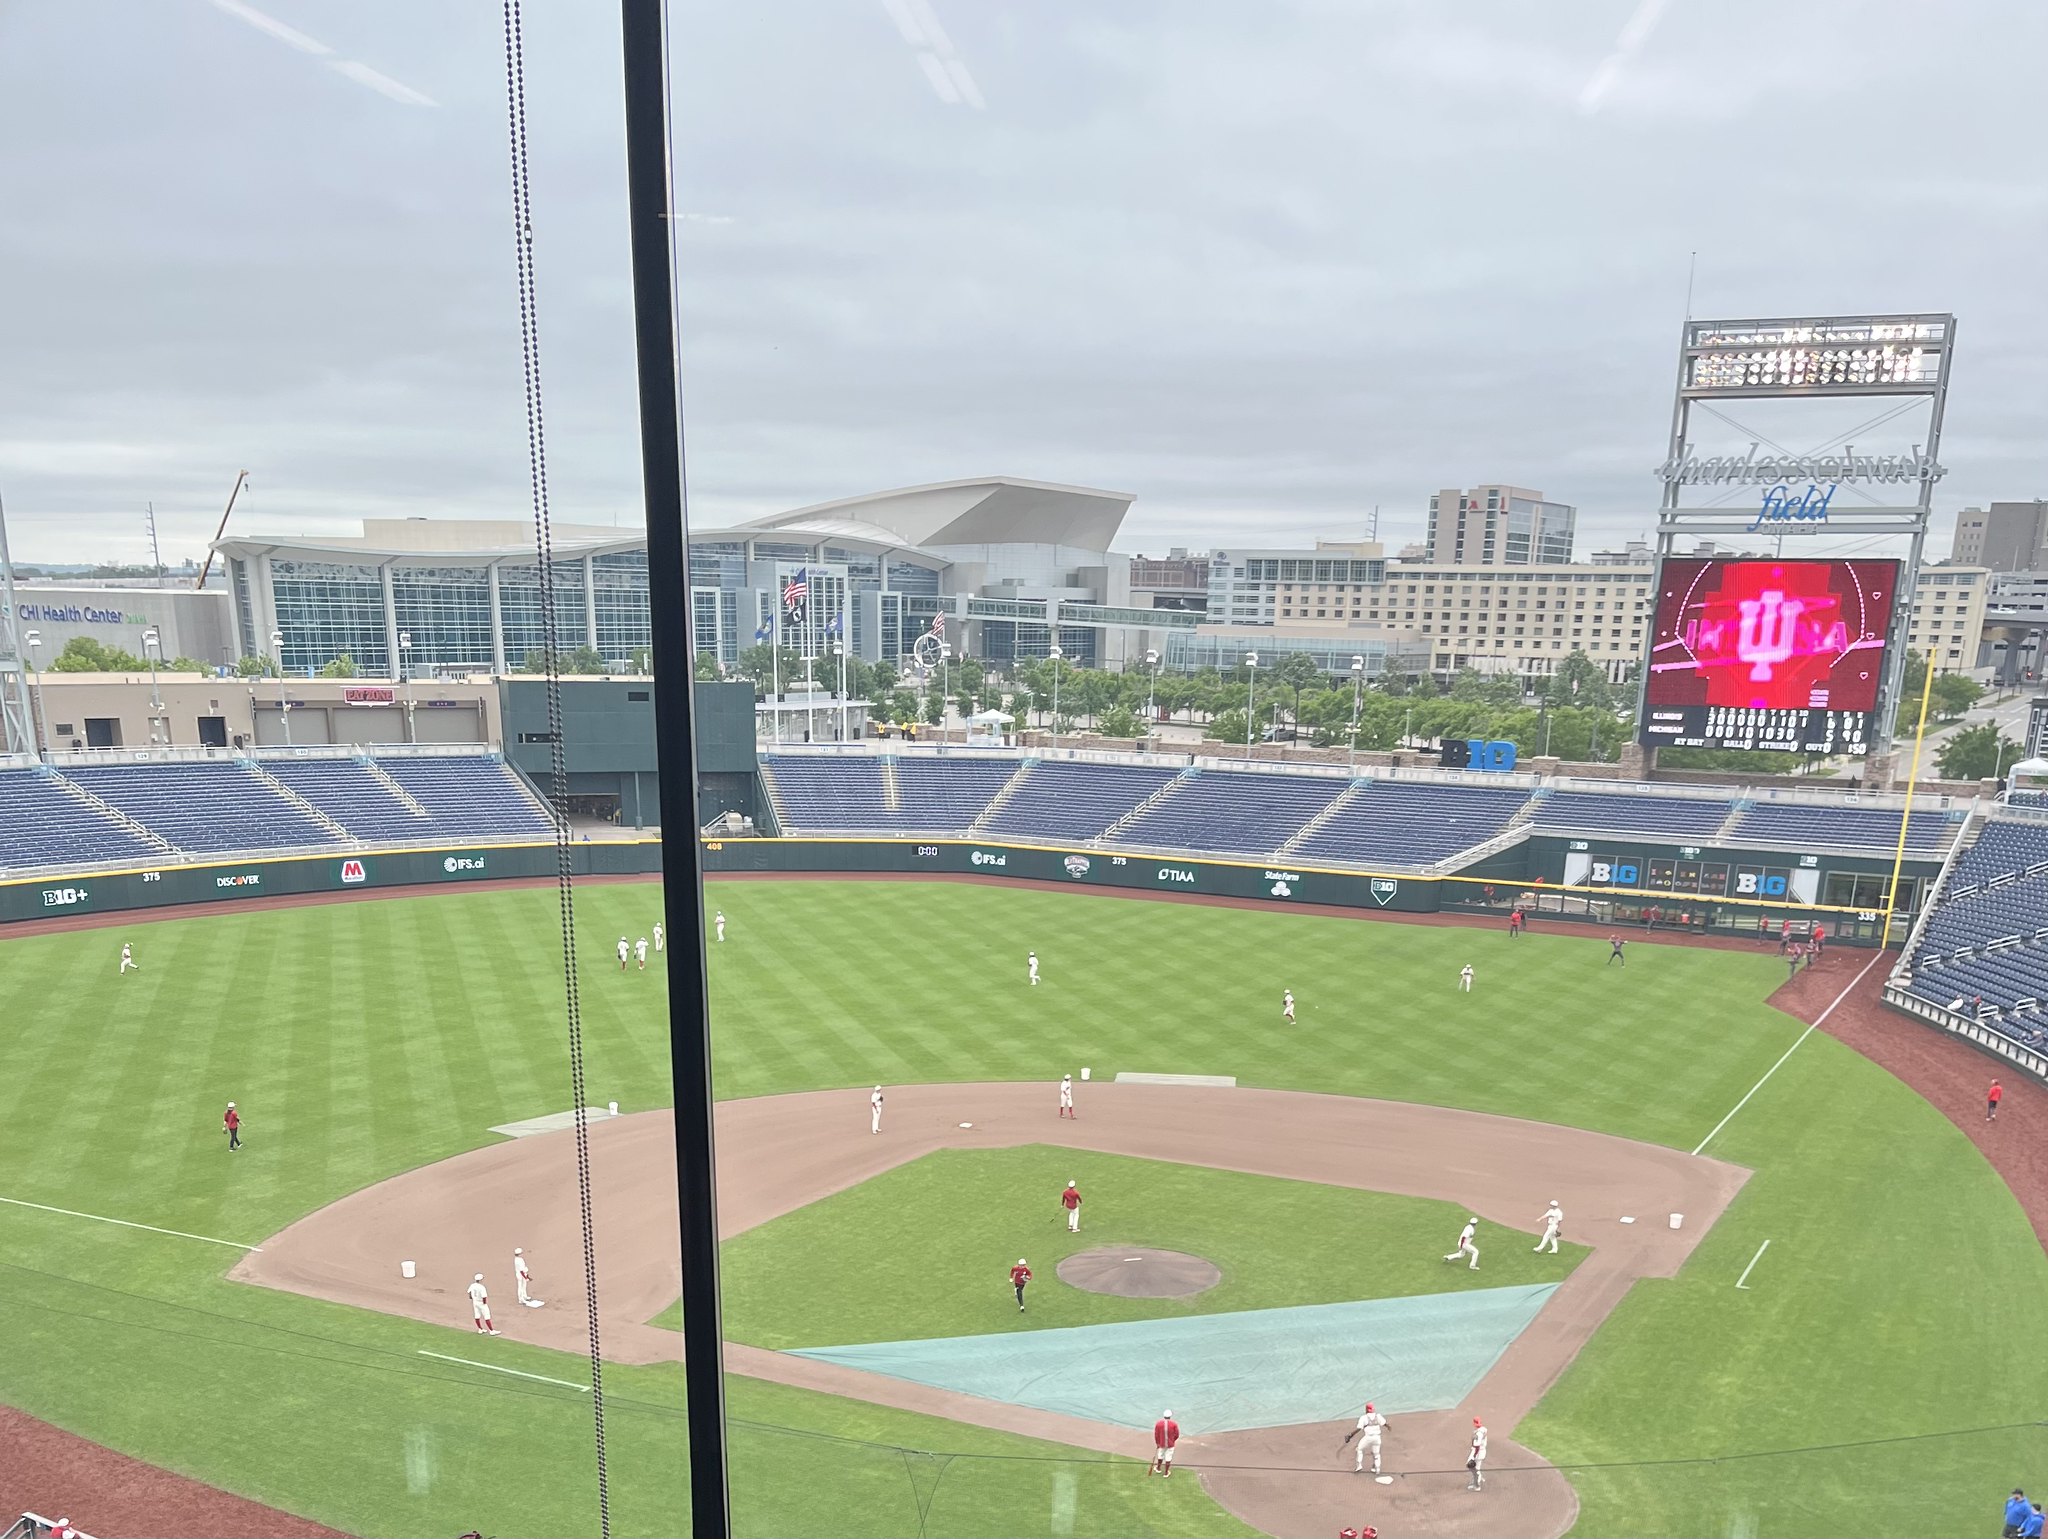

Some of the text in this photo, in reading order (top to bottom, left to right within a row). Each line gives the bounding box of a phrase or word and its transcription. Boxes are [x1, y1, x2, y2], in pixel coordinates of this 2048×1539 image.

[1746, 484, 1836, 532] field
[20, 604, 39, 620] CHI
[42, 604, 82, 622] Health
[83, 606, 123, 624] Center
[1717, 714, 1726, 725] 0
[1727, 714, 1736, 726] 0
[1737, 714, 1746, 726] 0
[1747, 715, 1756, 726] 0
[1757, 715, 1766, 727] 0
[1771, 716, 1776, 727] 1
[1781, 716, 1786, 727] 1
[1801, 717, 1807, 728] 1
[1705, 725, 1714, 738] 0
[1715, 726, 1724, 738] 0
[1725, 726, 1734, 738] 0
[1739, 727, 1744, 738] 1
[1745, 727, 1754, 739] 0
[1759, 728, 1764, 739] 1
[1766, 727, 1774, 740] 0
[1786, 728, 1795, 740] 0
[1852, 730, 1862, 743] 0
[706, 842, 723, 851] 408
[918, 846, 938, 856] 0:00
[457, 857, 485, 870] IFS.ai
[983, 855, 1006, 866] IFS.ai
[1112, 857, 1127, 866] 375
[142, 872, 160, 882] 375
[216, 874, 260, 887] DISCOVER
[1169, 869, 1195, 883] TIAA
[1858, 912, 1876, 922] 335
